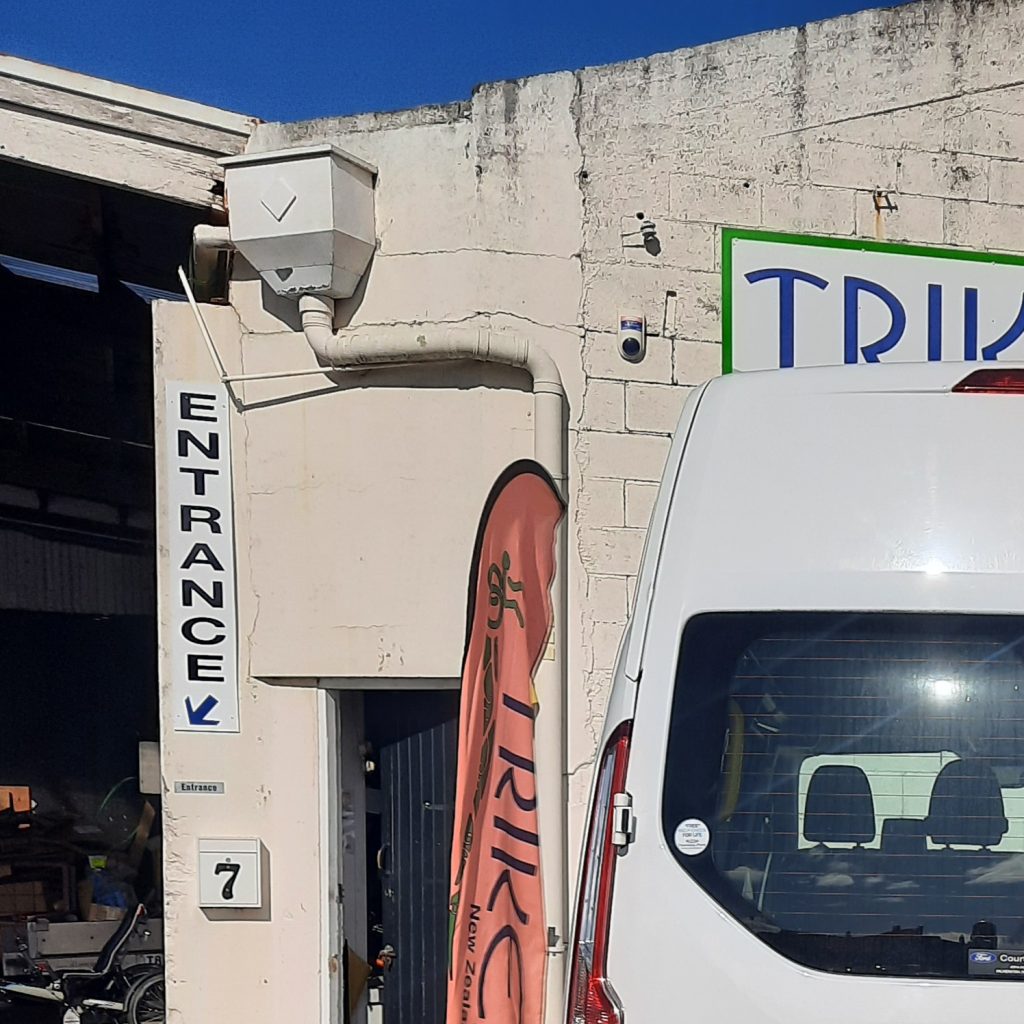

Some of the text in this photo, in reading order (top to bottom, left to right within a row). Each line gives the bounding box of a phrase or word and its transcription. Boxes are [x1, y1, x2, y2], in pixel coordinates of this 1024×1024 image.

[177, 392, 227, 683] ENTRANCE
[214, 863, 240, 900] 7
[467, 903, 481, 952] New
